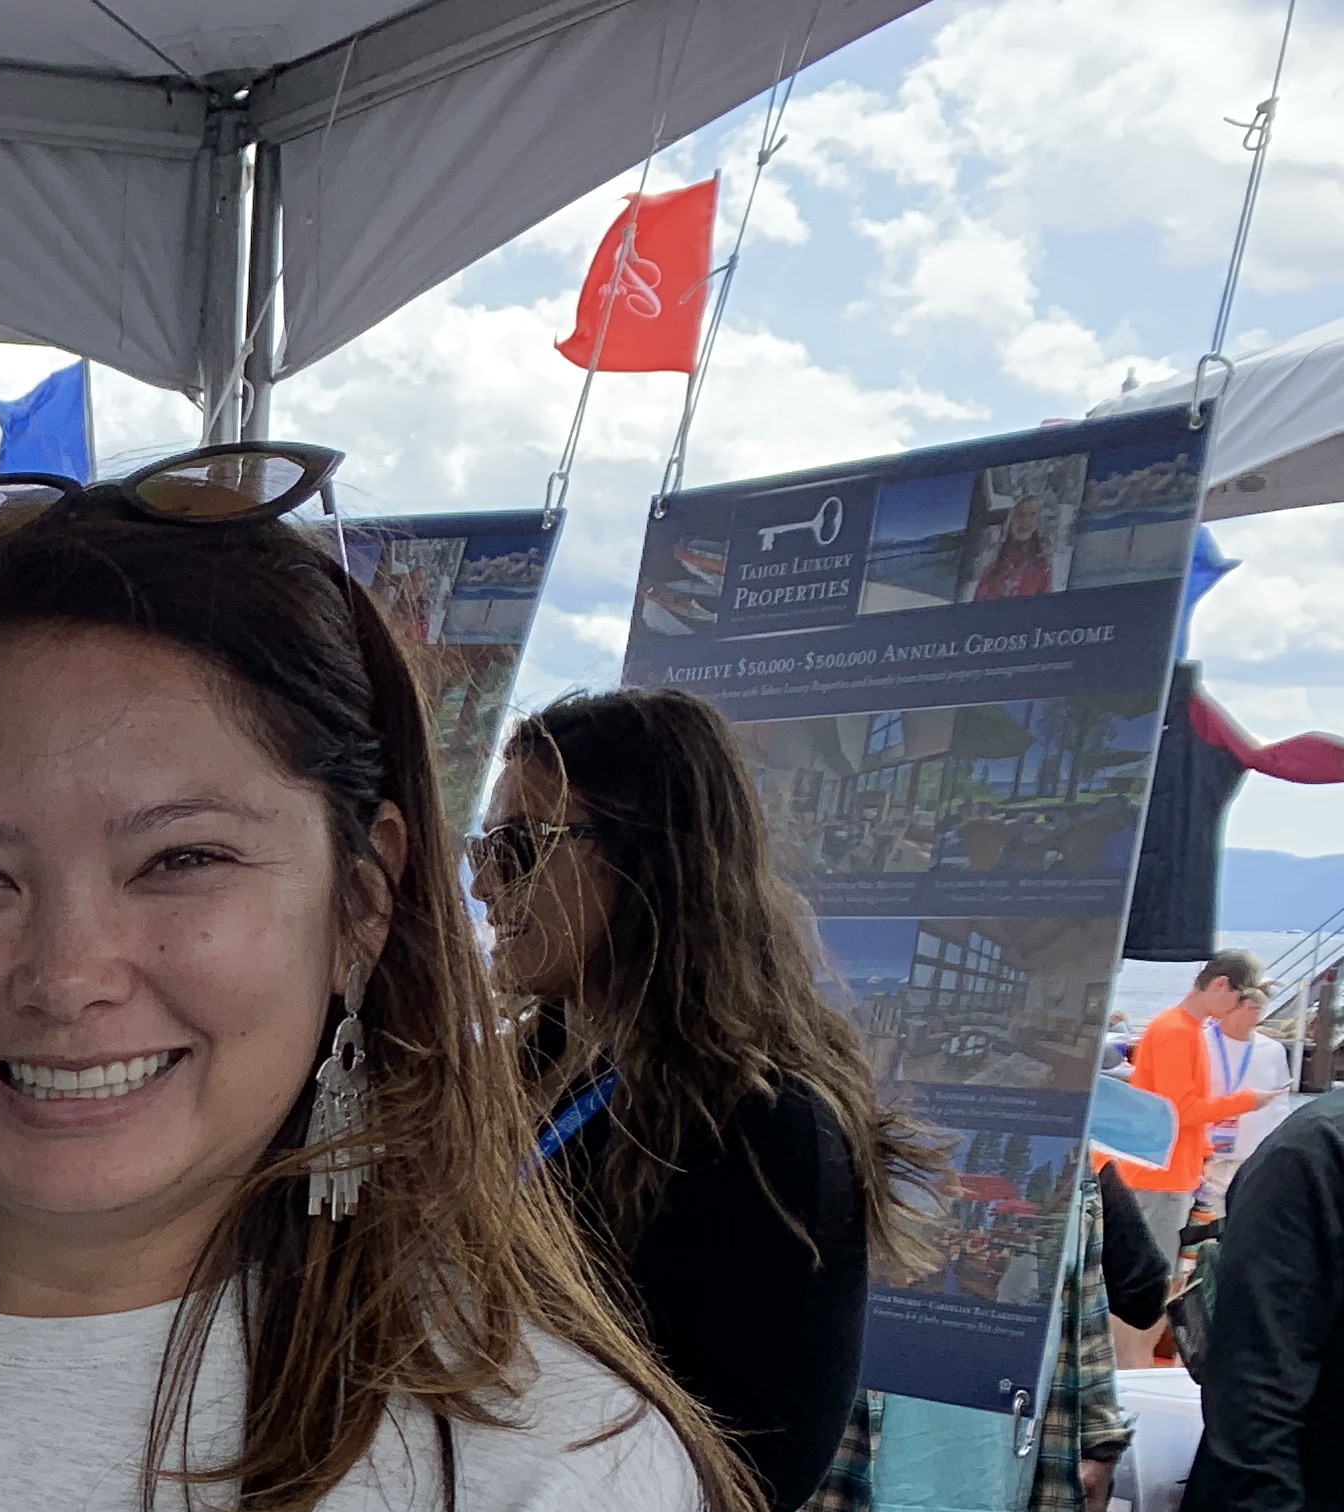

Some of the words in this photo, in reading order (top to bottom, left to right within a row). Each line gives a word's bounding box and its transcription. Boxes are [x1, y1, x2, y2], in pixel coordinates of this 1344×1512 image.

[738, 563, 789, 581] TAHOE
[792, 553, 854, 574] LUXURY
[732, 578, 850, 610] PROPERTIES
[663, 663, 733, 684] ACHIEVE
[881, 641, 960, 664] ANNUAL
[964, 633, 1028, 655] GROSS
[1033, 624, 1115, 649] INCOME
